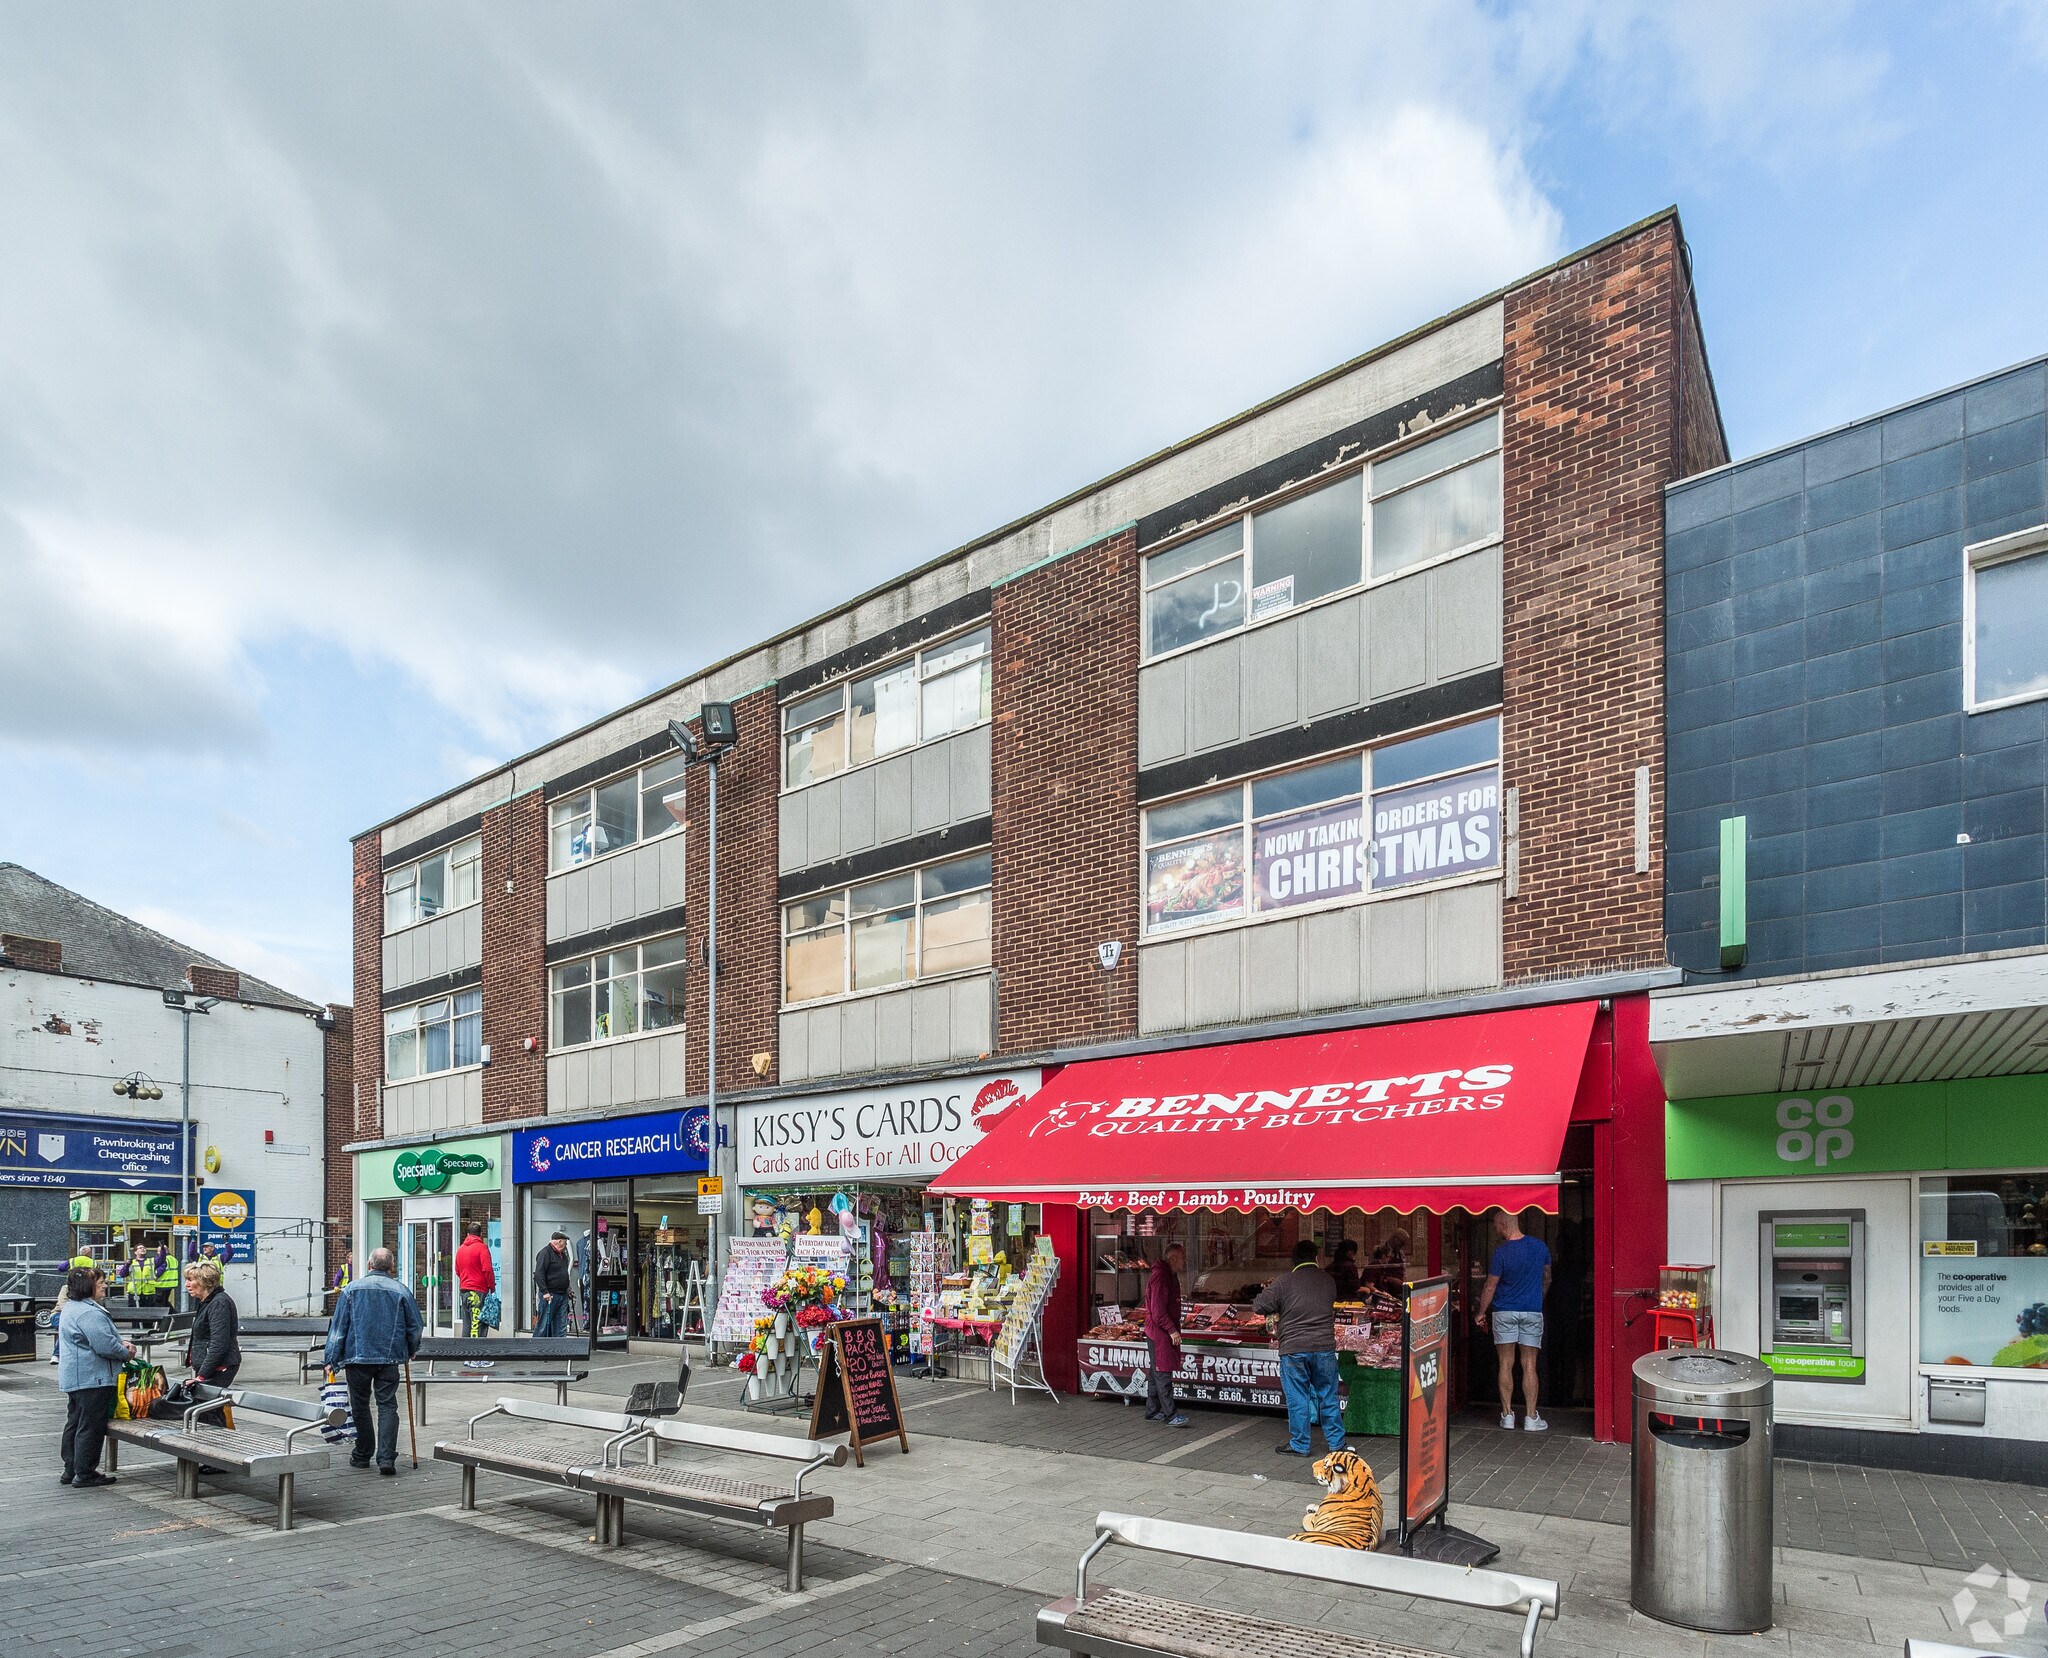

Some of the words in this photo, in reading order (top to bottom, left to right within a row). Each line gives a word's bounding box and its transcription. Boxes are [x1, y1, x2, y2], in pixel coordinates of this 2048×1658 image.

[1253, 578, 1291, 598] WARNING
[1264, 829, 1306, 858] NOW
[1375, 796, 1453, 833] ORDERS
[1457, 785, 1497, 815] FOR
[1268, 814, 1491, 900] CHRISTMAS
[1106, 1064, 1514, 1118] BENNETTS
[754, 1107, 845, 1147] KISSY'S
[856, 1095, 962, 1139] CARDS
[1088, 1116, 1258, 1137] QUALITY
[1261, 1093, 1505, 1129] BUTCHERS
[93, 1137, 155, 1150] Pawnbroking
[157, 1141, 174, 1151] and
[555, 1141, 602, 1161] CANCER
[605, 1134, 670, 1158] RESEARCH
[98, 1149, 170, 1164] Chequecashing
[752, 1152, 790, 1174] Cards
[794, 1149, 819, 1171] and
[826, 1147, 860, 1169] Gifts
[866, 1146, 893, 1167] For
[899, 1141, 921, 1165] All
[122, 1162, 148, 1172] office
[443, 1158, 484, 1168] Specsavers
[17, 1174, 40, 1183] since
[42, 1175, 65, 1184] 1840
[1077, 1191, 1114, 1205] Pork
[1127, 1190, 1166, 1206] Beef
[1178, 1189, 1229, 1206] Lamb
[1243, 1188, 1315, 1209] Poultry
[210, 1203, 246, 1215] cash
[732, 1239, 755, 1247] EVERYDAY
[798, 1238, 824, 1247] EVERYDAY
[1952, 1273, 2007, 1281] co-operative
[1938, 1284, 1972, 1292] provides
[1937, 1295, 1955, 1303] your
[1958, 1294, 1974, 1302] Five
[1984, 1295, 2001, 1304] Day
[1938, 1305, 1962, 1313] foods.
[1183, 1354, 1198, 1372] &
[1770, 1355, 1784, 1364] The
[1785, 1358, 1836, 1367] co-operative
[1838, 1359, 1856, 1367] food
[1172, 1371, 1198, 1381] NOW
[1201, 1372, 1213, 1382] IN
[1216, 1373, 1257, 1384] STORE
[1420, 1359, 1438, 1389] £25
[1173, 1387, 1182, 1397] £5
[1197, 1389, 1206, 1399] £5
[1219, 1391, 1241, 1402] £6.60
[1252, 1393, 1280, 1405] £18.50
